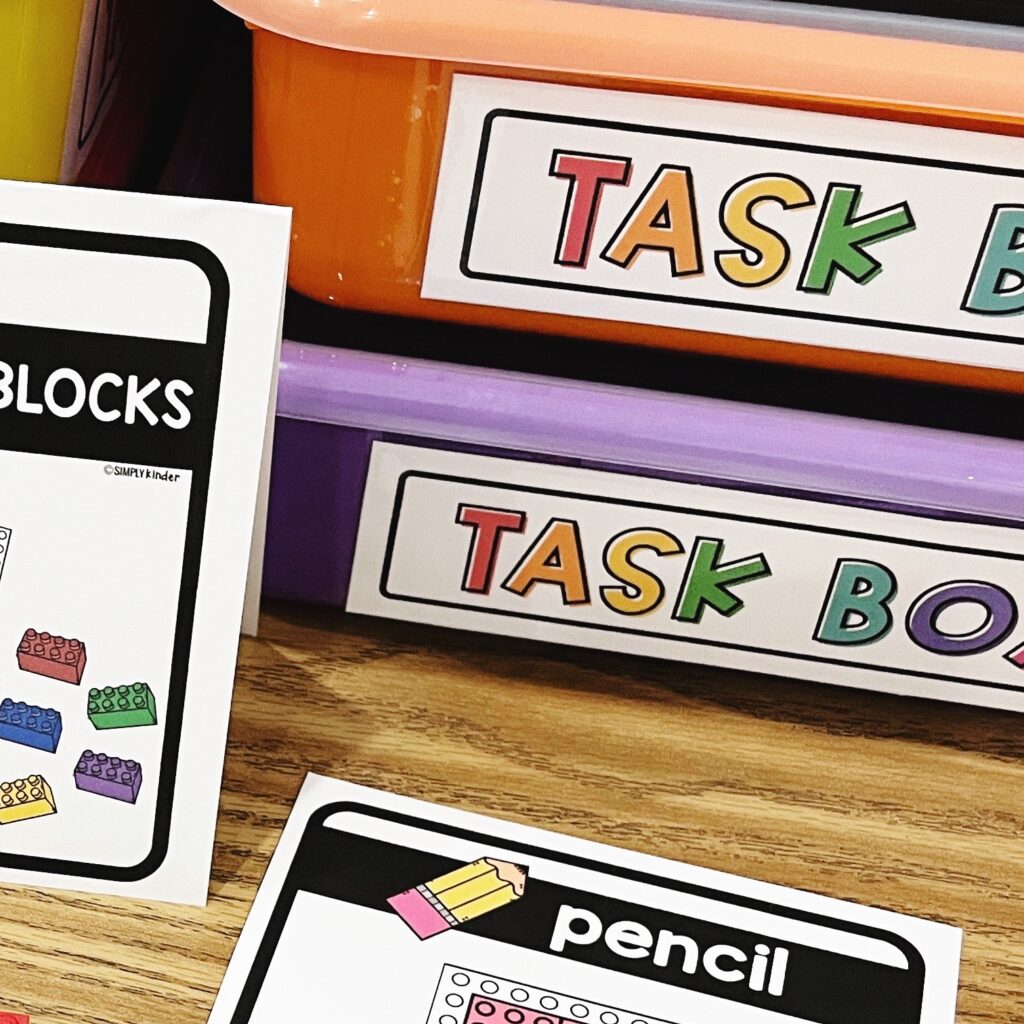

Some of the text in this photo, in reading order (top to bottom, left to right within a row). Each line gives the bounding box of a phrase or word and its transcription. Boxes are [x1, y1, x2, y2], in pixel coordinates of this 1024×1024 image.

[549, 149, 916, 295] TASK
[455, 503, 1024, 670] TASK BO
[550, 903, 789, 997] pencil
